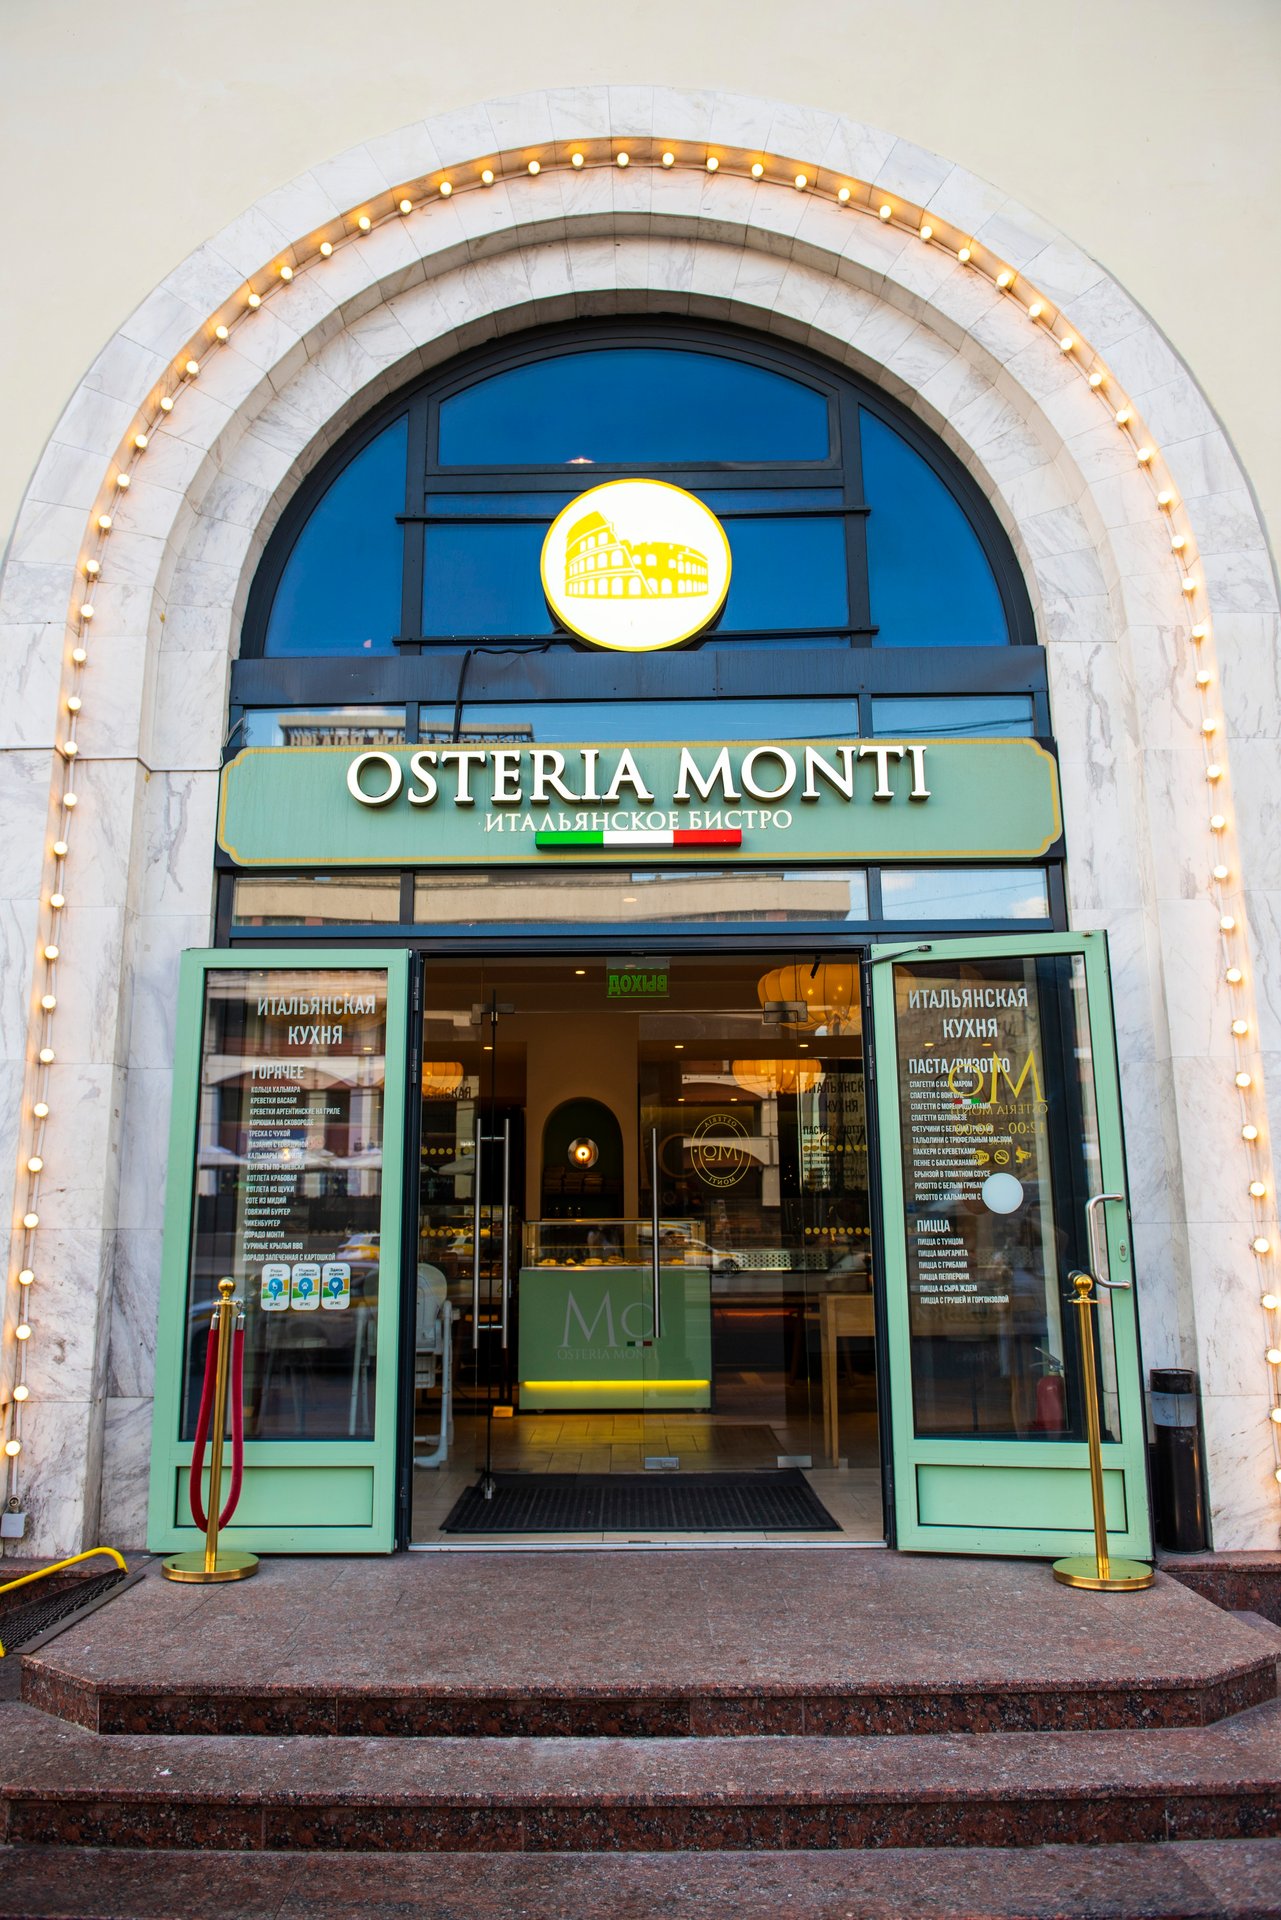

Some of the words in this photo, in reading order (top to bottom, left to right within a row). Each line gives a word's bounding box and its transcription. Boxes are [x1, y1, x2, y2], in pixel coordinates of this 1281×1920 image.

[347, 748, 655, 806] OSTERIA
[673, 746, 932, 802] MONTI
[484, 811, 680, 832] ИТАЛЬЯНСКОЕ
[689, 810, 793, 830] БИСТРО
[909, 988, 1028, 1009] ИТАЛЬЯНСКАЯ
[257, 994, 376, 1015] ИТАЛЬЯНСКАЯ
[943, 1018, 998, 1038] КУХНЯ
[288, 1025, 342, 1045] КУХНЯ
[909, 1058, 1011, 1074] ПАСТА/РИЗОТТО
[252, 1064, 304, 1080] ГОРЯЧЕЕ
[909, 1080, 935, 1088] СПАГЕТТИ
[940, 1080, 973, 1088] КАЛМАРОМ
[249, 1129, 268, 1137] ТРЕСКА
[246, 1174, 270, 1182] КОТЛЕТА
[914, 1170, 939, 1178] БРЫНЗОЙ
[944, 1170, 973, 1178] ТОМАТНОМ
[974, 1170, 991, 1178] СОУСЕ
[246, 1185, 269, 1193] КОТЛЕТА
[917, 1220, 951, 1233] ПИЦЦА
[917, 1238, 936, 1246] ПИЦЦА
[918, 1261, 937, 1269] ПИЦЦА
[942, 1261, 968, 1269] ГРИБАМИ
[919, 1273, 938, 1281] ПИЦЦА
[938, 1273, 970, 1281] ПЕППЕРОНИ
[920, 1295, 939, 1304] ПИЦЦА
